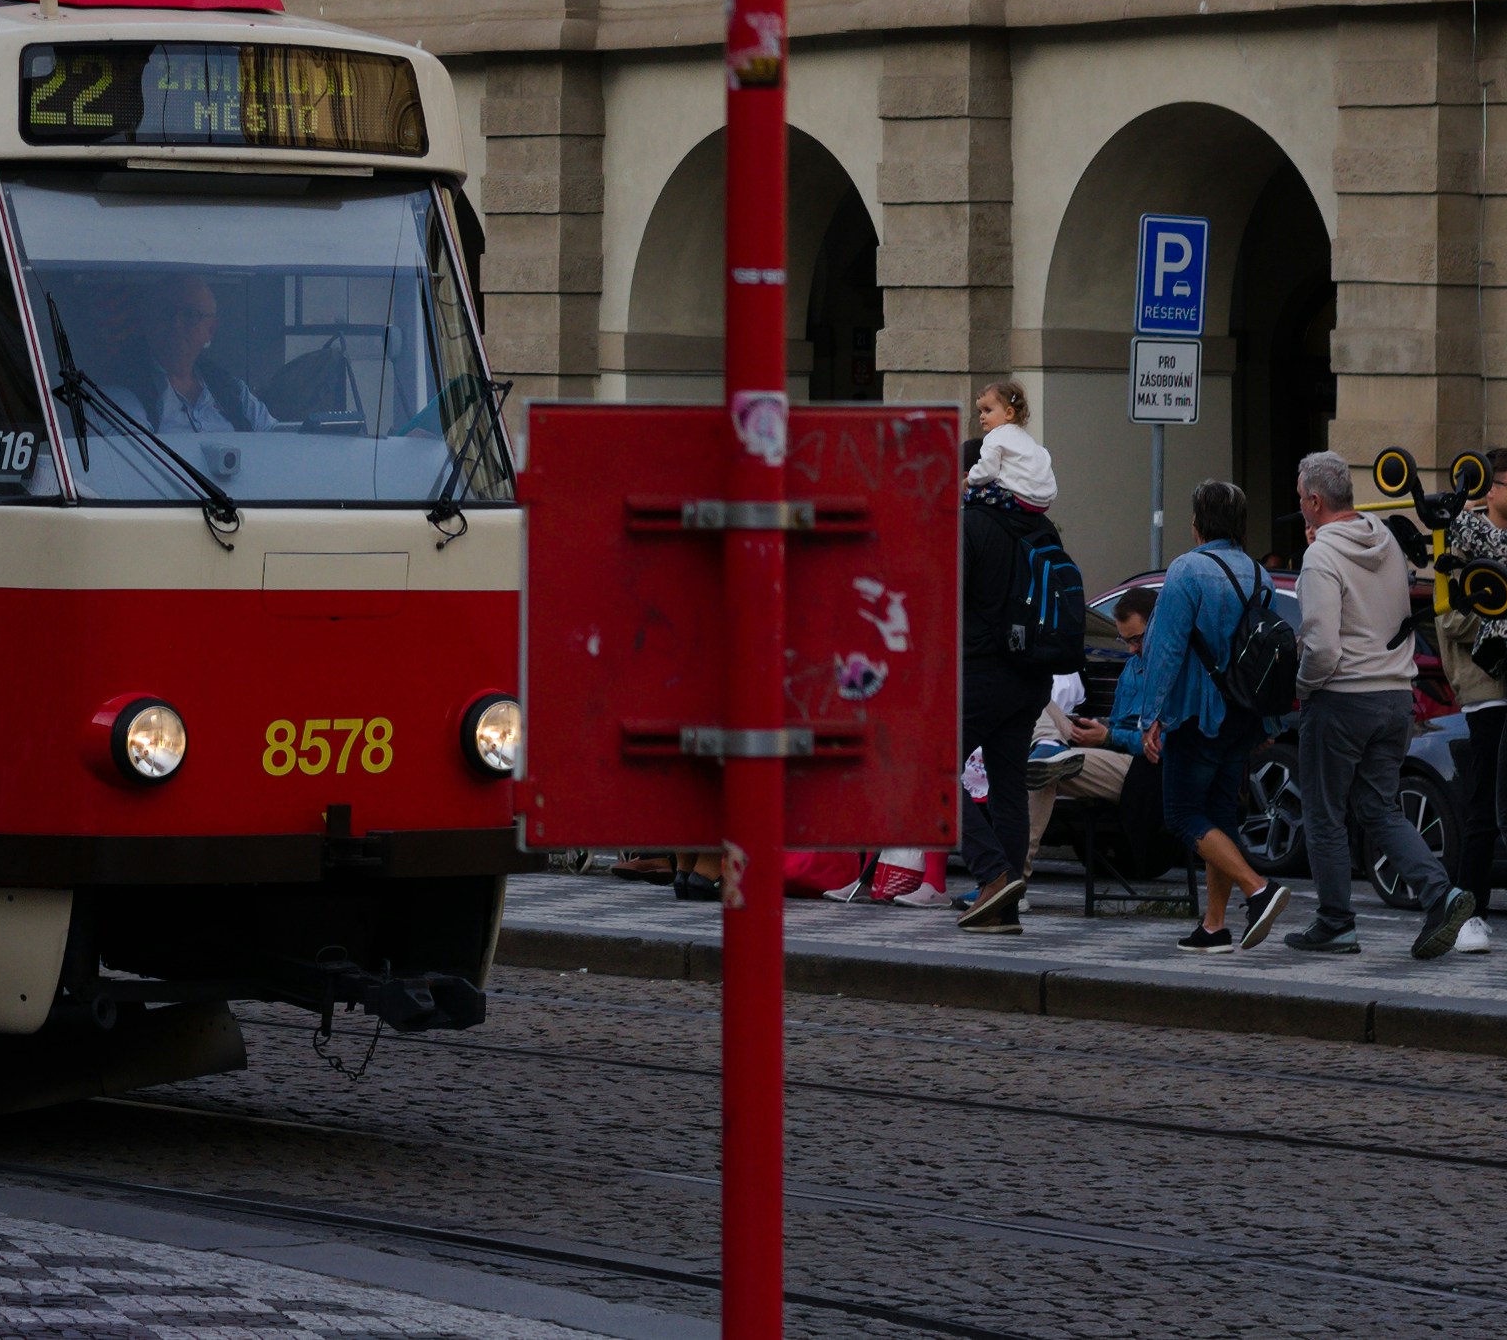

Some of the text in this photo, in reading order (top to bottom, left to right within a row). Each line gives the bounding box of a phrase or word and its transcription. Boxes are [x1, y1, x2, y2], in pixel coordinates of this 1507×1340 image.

[30, 55, 114, 127] 22
[1154, 231, 1193, 297] P
[1145, 303, 1197, 321] RÉSERVÉ
[1158, 356, 1176, 369] PRO
[1140, 370, 1193, 388] ZÁSOBOVÁNÍ
[1137, 392, 1194, 407] MAX. 15 min.
[263, 716, 394, 777] 8578
